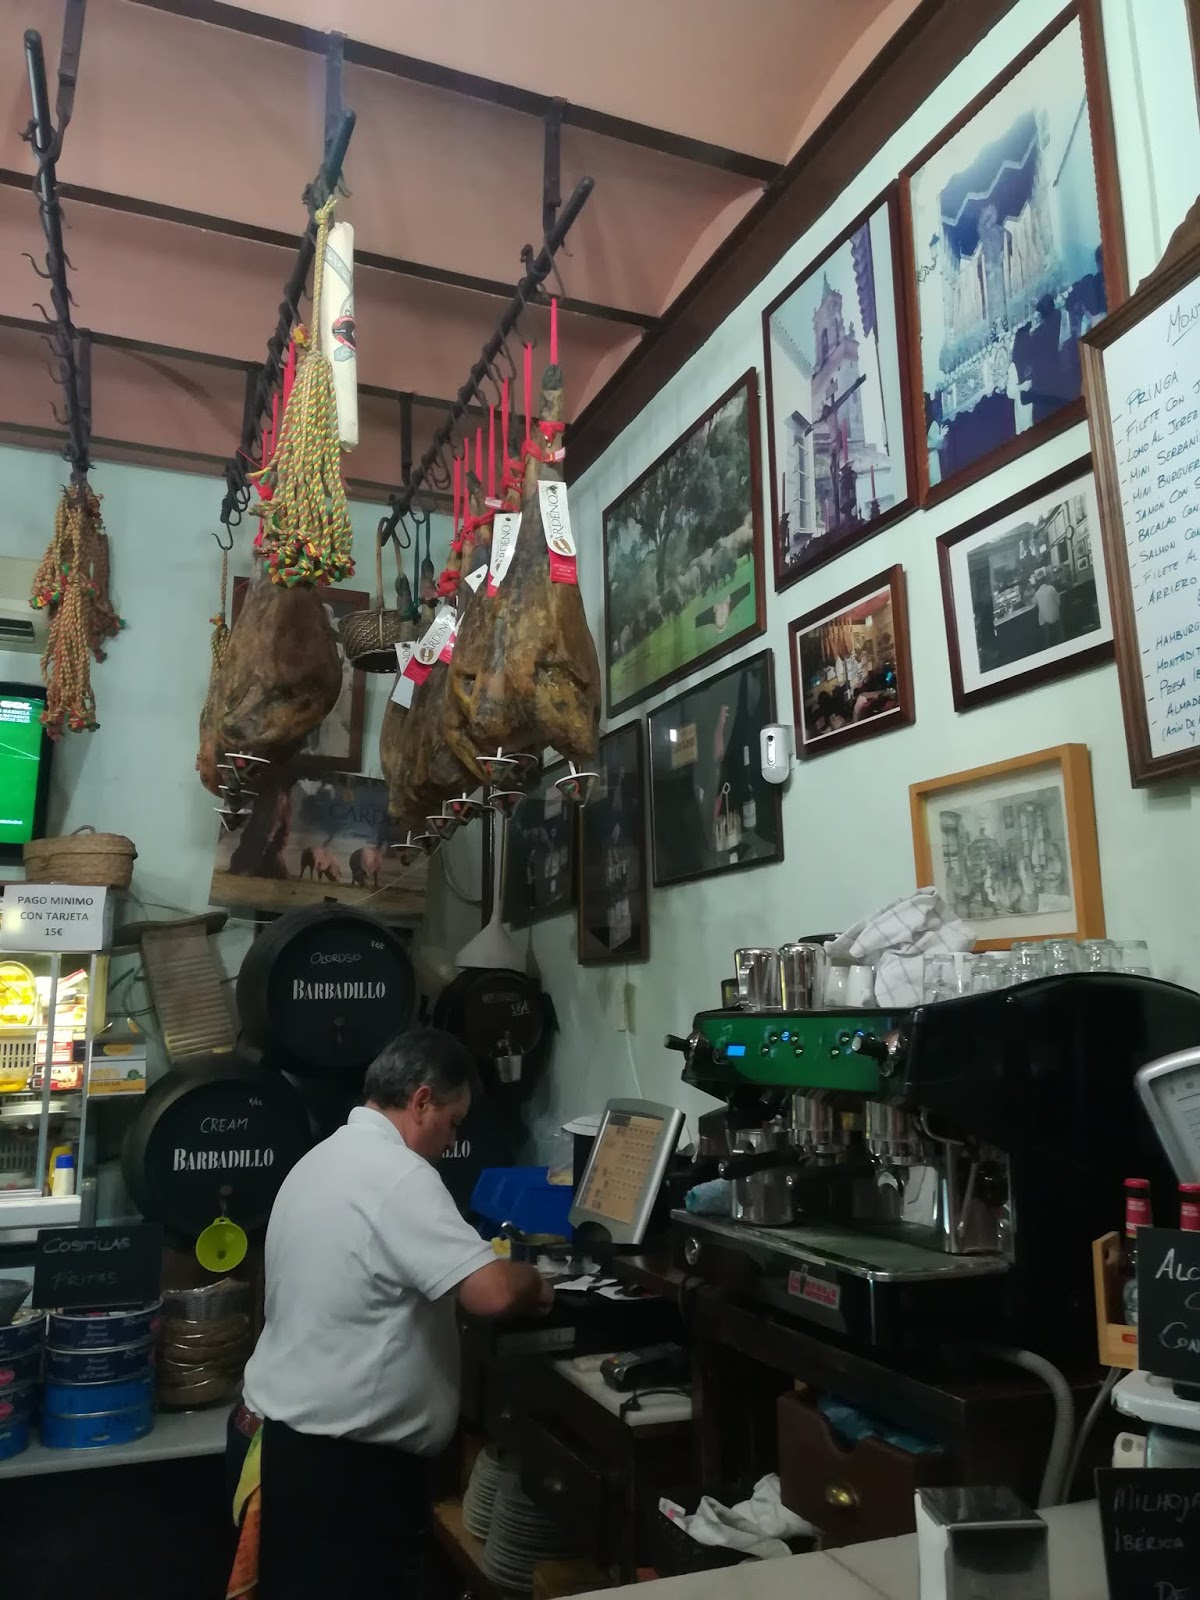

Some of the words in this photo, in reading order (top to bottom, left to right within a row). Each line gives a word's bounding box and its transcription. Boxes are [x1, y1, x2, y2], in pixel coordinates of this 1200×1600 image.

[1125, 408, 1160, 442] FILETE
[1166, 395, 1185, 412] CON
[1127, 443, 1149, 463] LOMO
[1152, 430, 1164, 446] AL
[1168, 410, 1198, 436] JEREZ
[1130, 465, 1150, 484] MINI
[1133, 485, 1152, 503] MINI
[1169, 486, 1188, 504] CON
[1138, 516, 1177, 542] BACALAO
[1182, 503, 1199, 518] CON
[1142, 561, 1179, 584] FILETE
[1148, 577, 1197, 606] ARRIERO
[1160, 677, 1186, 700] PRESA
[17, 896, 47, 905] PAGO
[50, 897, 94, 906] MINIMO
[20, 911, 43, 920] CON
[46, 912, 89, 921] TARJETA
[44, 927, 63, 936] 15€
[310, 951, 362, 965] OLOROSO
[292, 979, 386, 1000] BARBADILLO
[200, 1116, 249, 1133] CREAM
[173, 1148, 275, 1171] BARBADILLO
[43, 1236, 131, 1254] COSTILLAS
